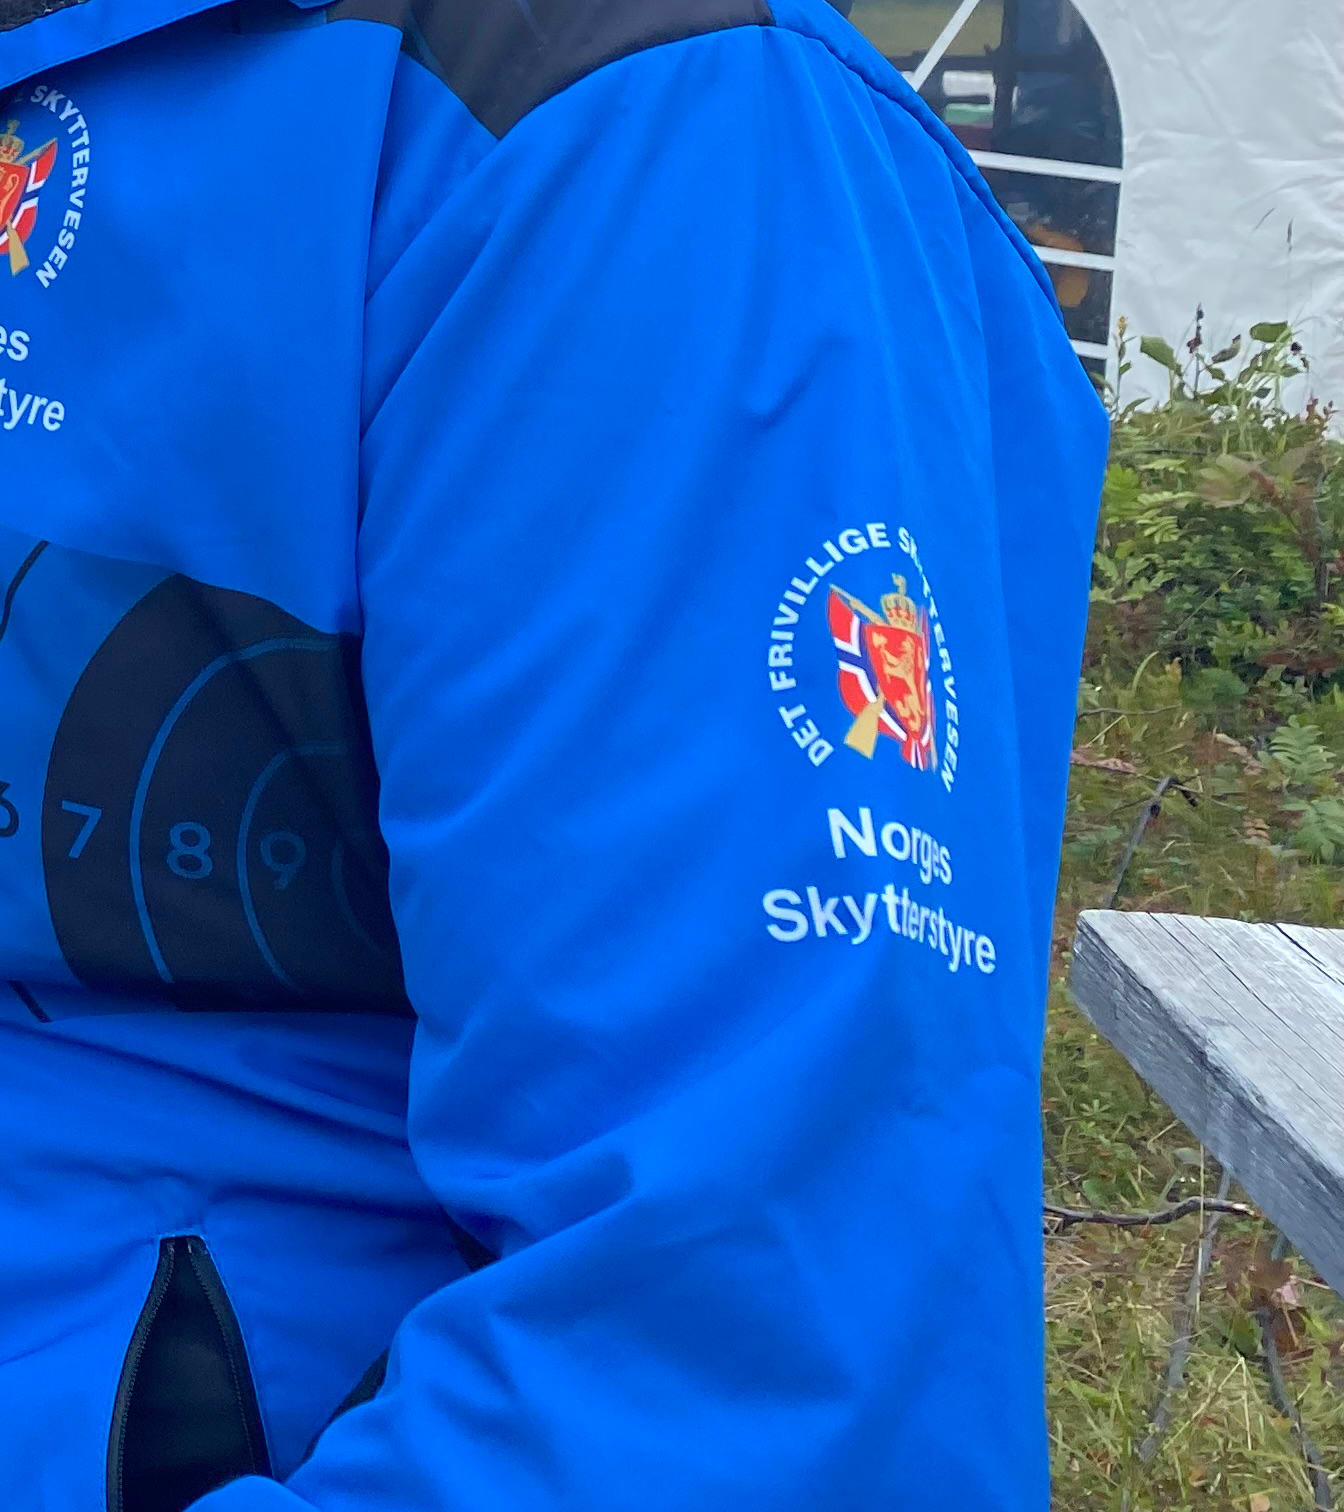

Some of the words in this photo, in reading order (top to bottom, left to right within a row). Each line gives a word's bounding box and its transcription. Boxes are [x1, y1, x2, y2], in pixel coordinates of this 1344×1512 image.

[30, 85, 91, 288] SKYTTERVESEN
[768, 523, 891, 693] FRIVILLIGE
[778, 704, 835, 767] DET
[62, 799, 103, 860] 7
[166, 822, 213, 879] 8
[259, 831, 307, 892] 9
[828, 807, 952, 885] Norges
[763, 884, 996, 975] Skytterstyre
